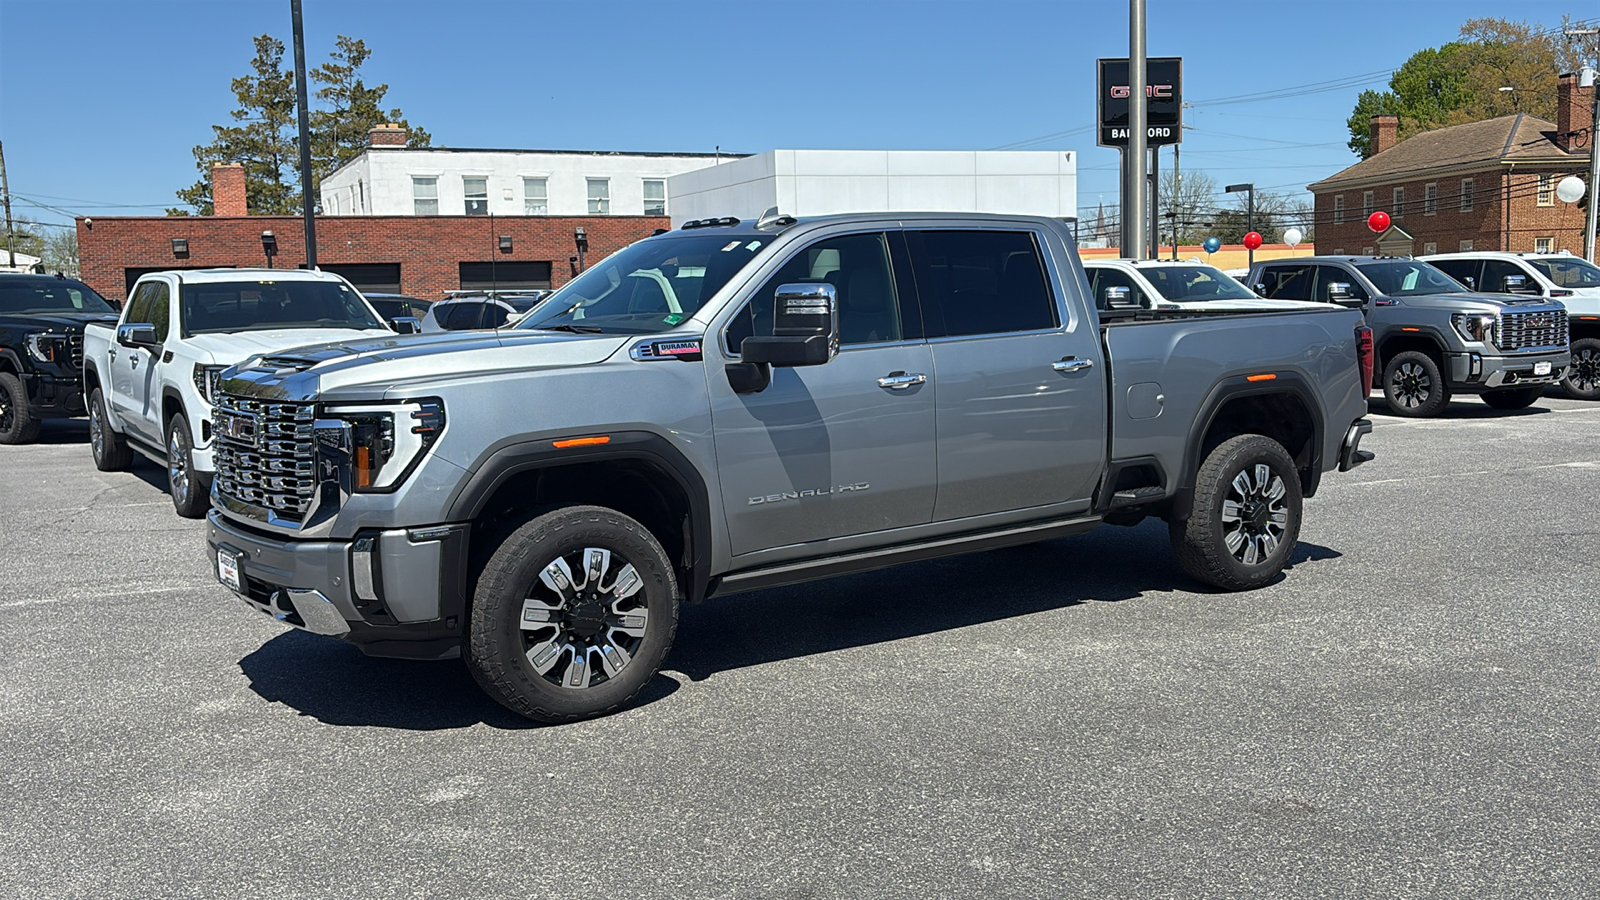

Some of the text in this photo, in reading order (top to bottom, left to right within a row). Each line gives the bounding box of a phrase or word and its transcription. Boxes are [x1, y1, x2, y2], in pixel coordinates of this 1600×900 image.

[1110, 84, 1173, 98] GC
[748, 481, 870, 506] DENALI HD
